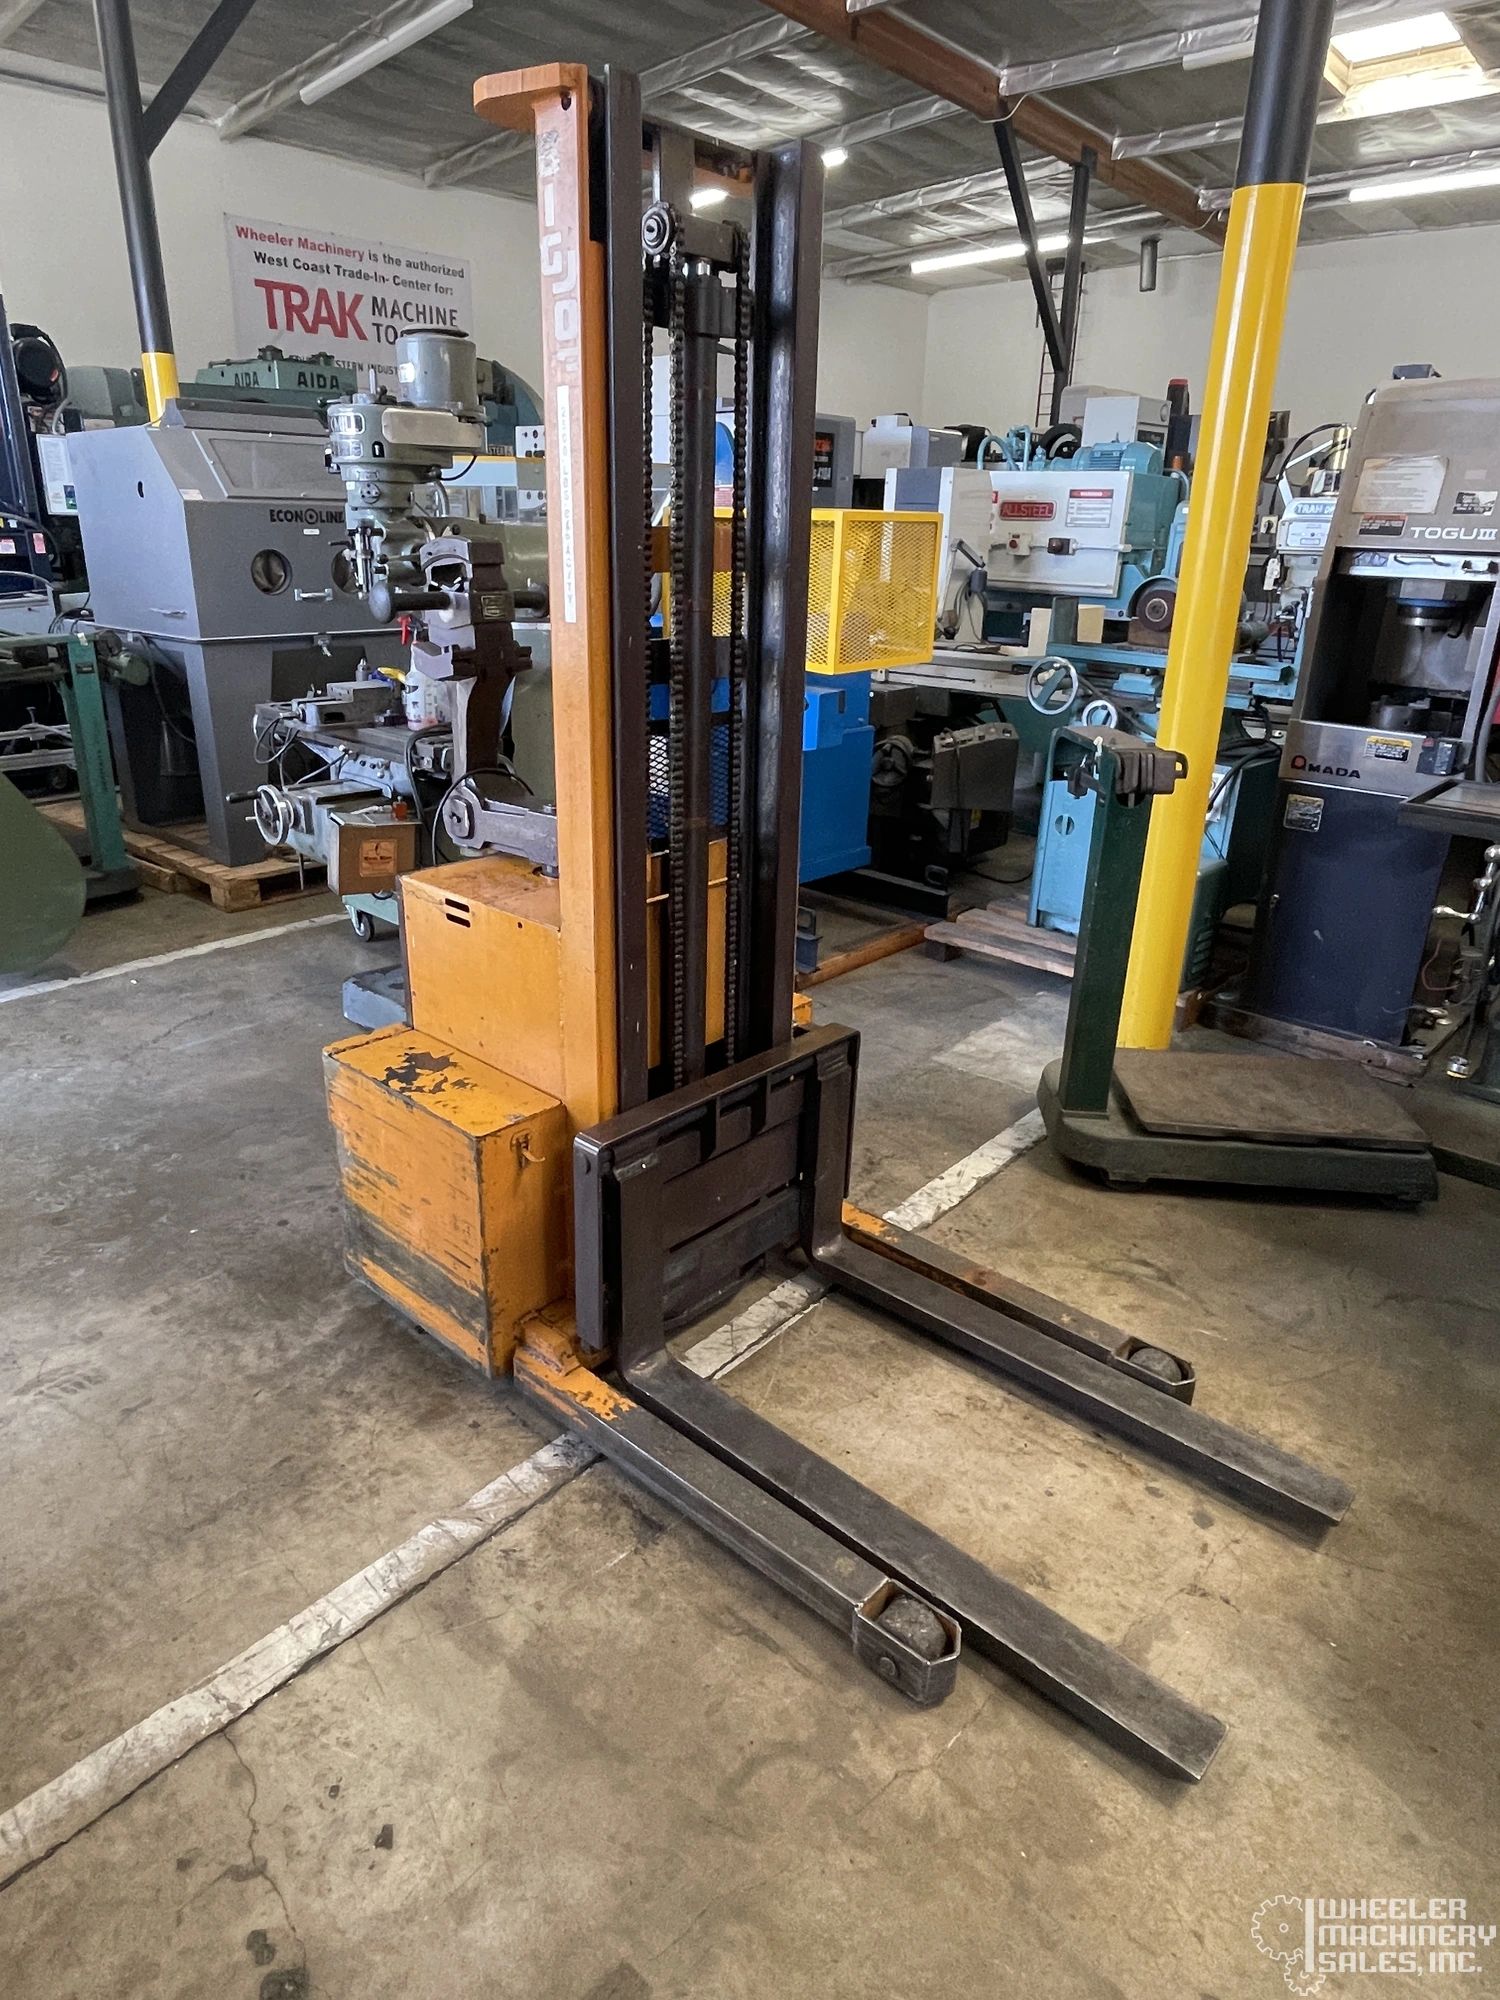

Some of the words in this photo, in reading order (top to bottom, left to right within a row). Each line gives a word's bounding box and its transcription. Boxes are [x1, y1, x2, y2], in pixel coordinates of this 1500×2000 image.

[235, 225, 294, 247] Wheeler
[298, 237, 365, 262] Machinery
[368, 249, 379, 263] is
[382, 253, 402, 267] the
[405, 260, 465, 279] authorized
[253, 251, 289, 268] West
[293, 258, 331, 275] Coast
[392, 275, 432, 292] Center
[434, 282, 454, 296] for:
[253, 278, 369, 341] TRAK
[371, 295, 458, 327] MACHINE
[371, 322, 398, 345] TO
[234, 371, 260, 387] AIDA
[297, 371, 340, 390] AIDA
[367, 363, 399, 375] INDUST
[1001, 503, 1053, 517] ALLSTEEL
[1291, 755, 1361, 779] AMADA
